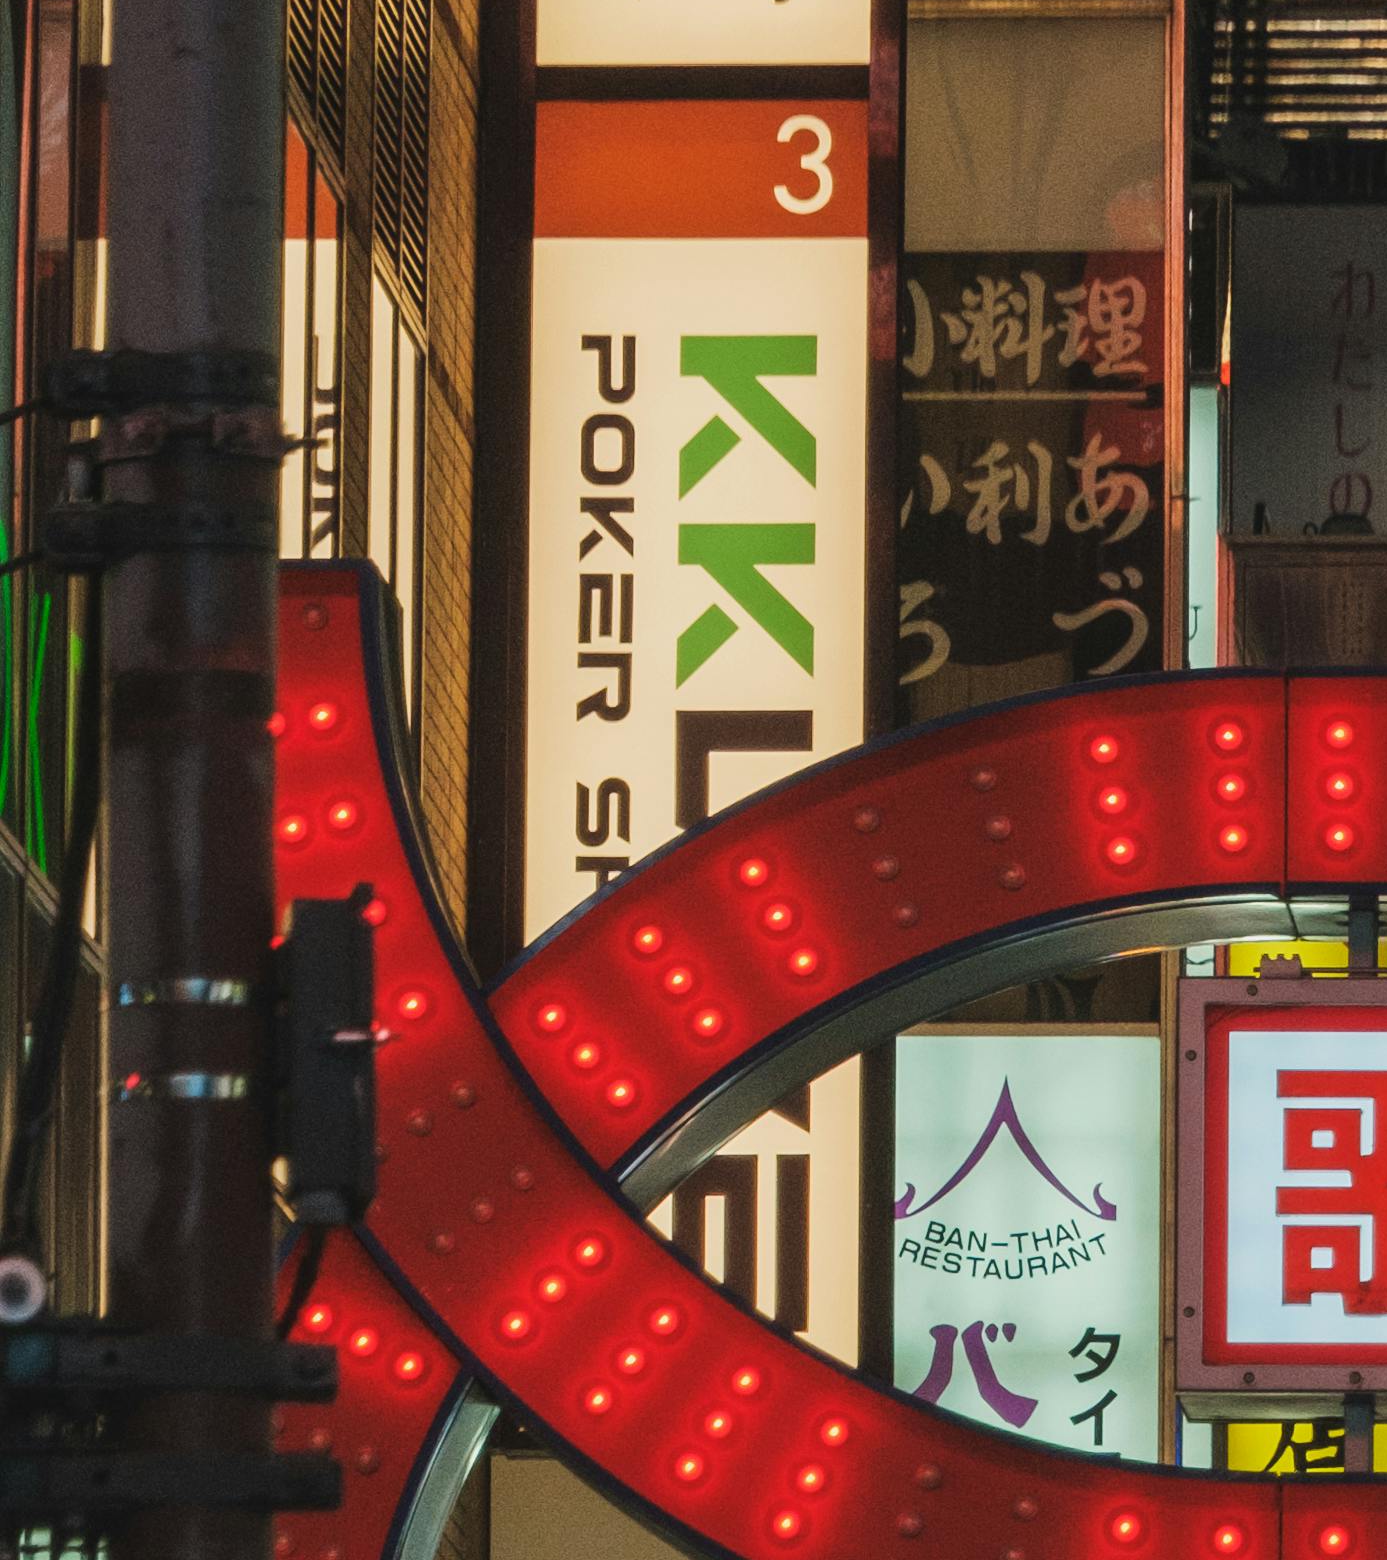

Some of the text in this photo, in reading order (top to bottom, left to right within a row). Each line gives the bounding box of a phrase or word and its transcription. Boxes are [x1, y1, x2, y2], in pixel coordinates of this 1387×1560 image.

[772, 113, 834, 216] 3
[577, 334, 638, 724] POKER
[898, 1231, 1109, 1281] RESTAURANT
[923, 1218, 1083, 1256] BAN-THAI
